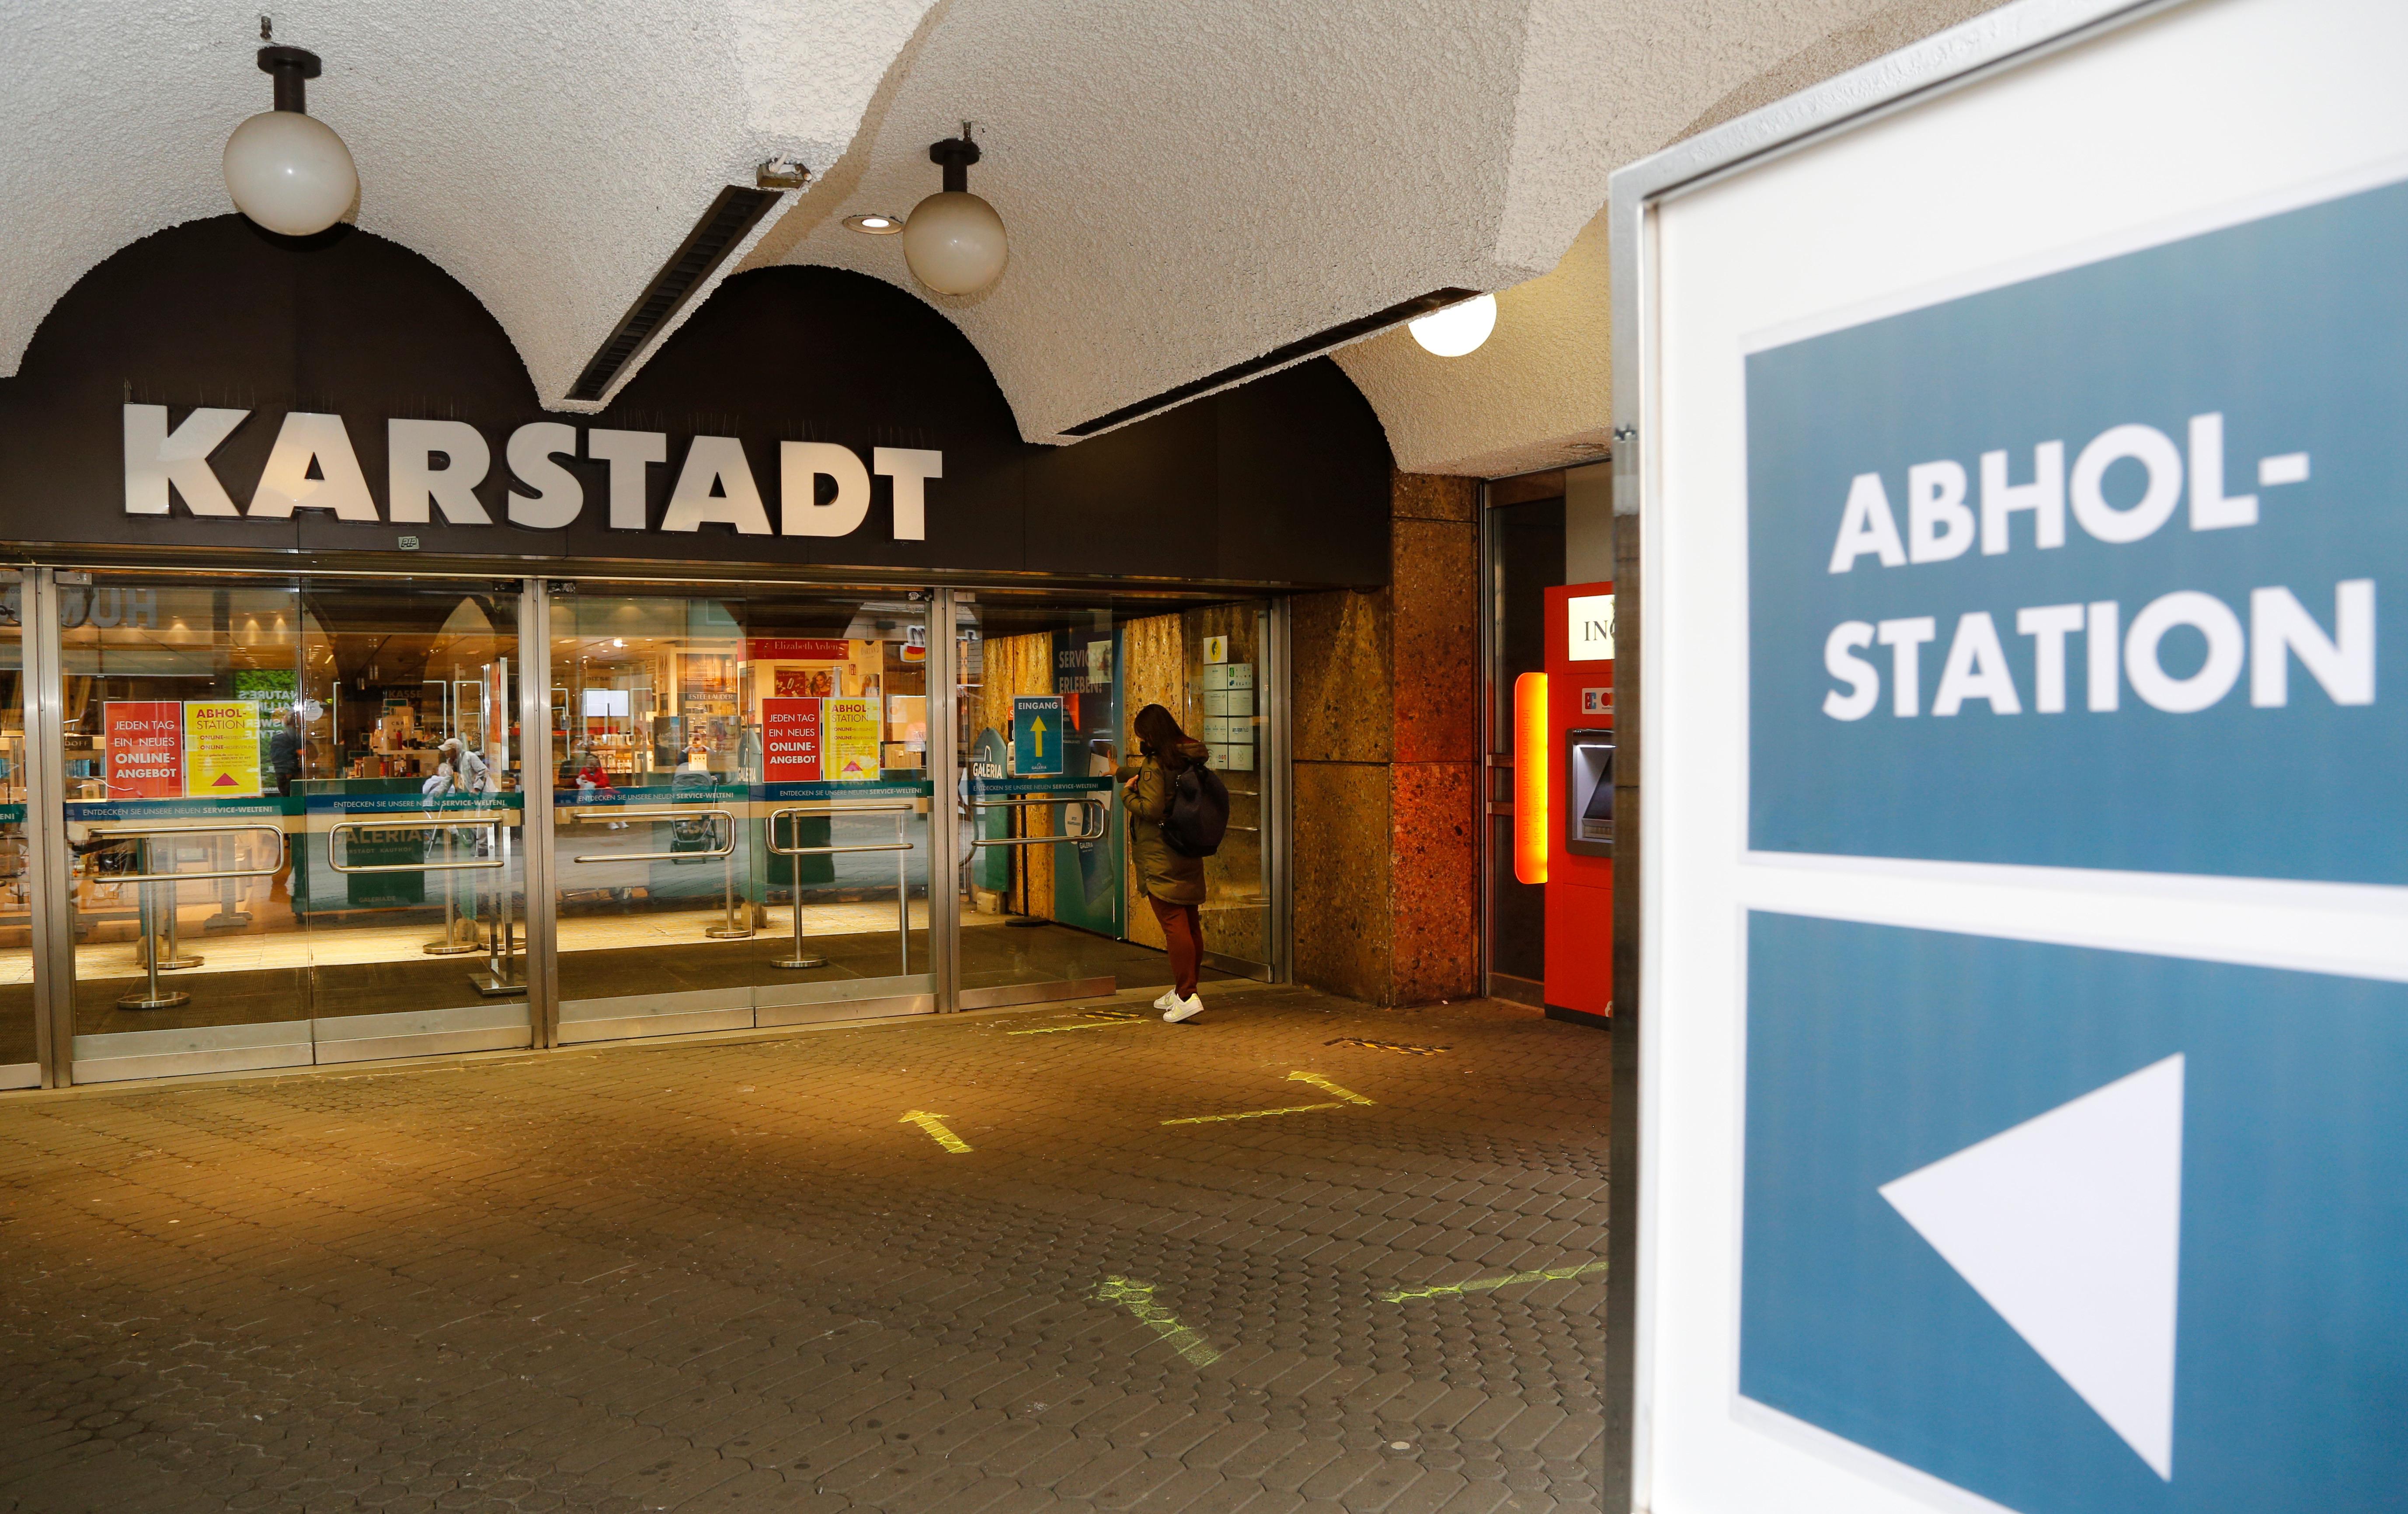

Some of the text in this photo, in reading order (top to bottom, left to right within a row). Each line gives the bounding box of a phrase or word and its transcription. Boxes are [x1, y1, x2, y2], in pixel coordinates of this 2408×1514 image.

[124, 403, 943, 542] KARSTADT
[1827, 411, 2310, 574] ABHOL-
[775, 641, 838, 651] Elizabeth Arden
[1822, 579, 2375, 722] STATION
[1059, 676, 1102, 693] ERLEBEN!
[388, 690, 423, 698] KASSE
[196, 708, 247, 718] ABHOL-
[832, 704, 870, 712] ABHOL-
[114, 720, 174, 731] JEDEN TAG
[197, 720, 245, 730] STATION
[769, 729, 783, 737] EIN
[114, 737, 174, 748] EIN NEUES
[769, 742, 815, 751] ONLINE-
[115, 752, 175, 764] ONLINE-
[770, 755, 816, 764] ANGEBOT
[116, 768, 177, 778] ANGEBOT
[973, 762, 1002, 779] GALERIA
